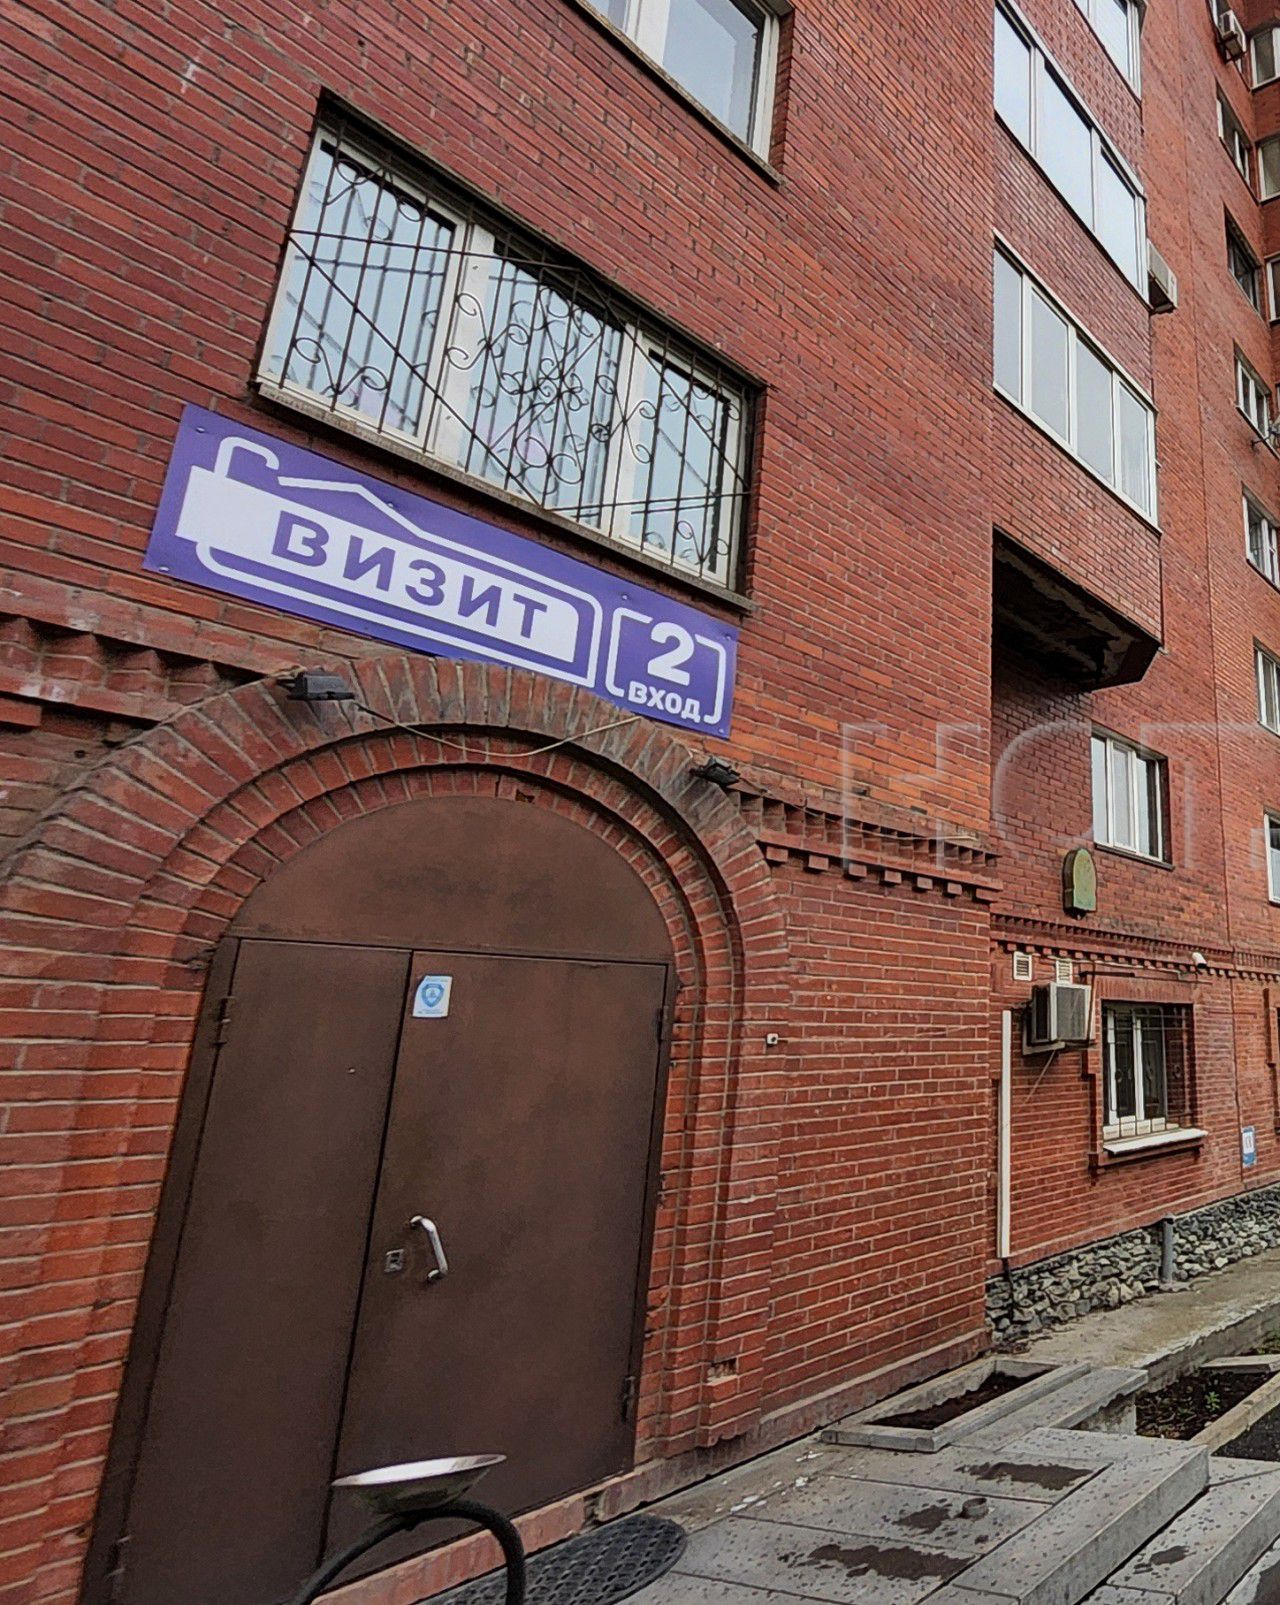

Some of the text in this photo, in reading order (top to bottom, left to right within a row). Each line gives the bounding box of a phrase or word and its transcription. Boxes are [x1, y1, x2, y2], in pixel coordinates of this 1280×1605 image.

[271, 511, 548, 640] ВИЗИТ
[647, 620, 695, 686] 2
[628, 681, 702, 724] ВХОД
